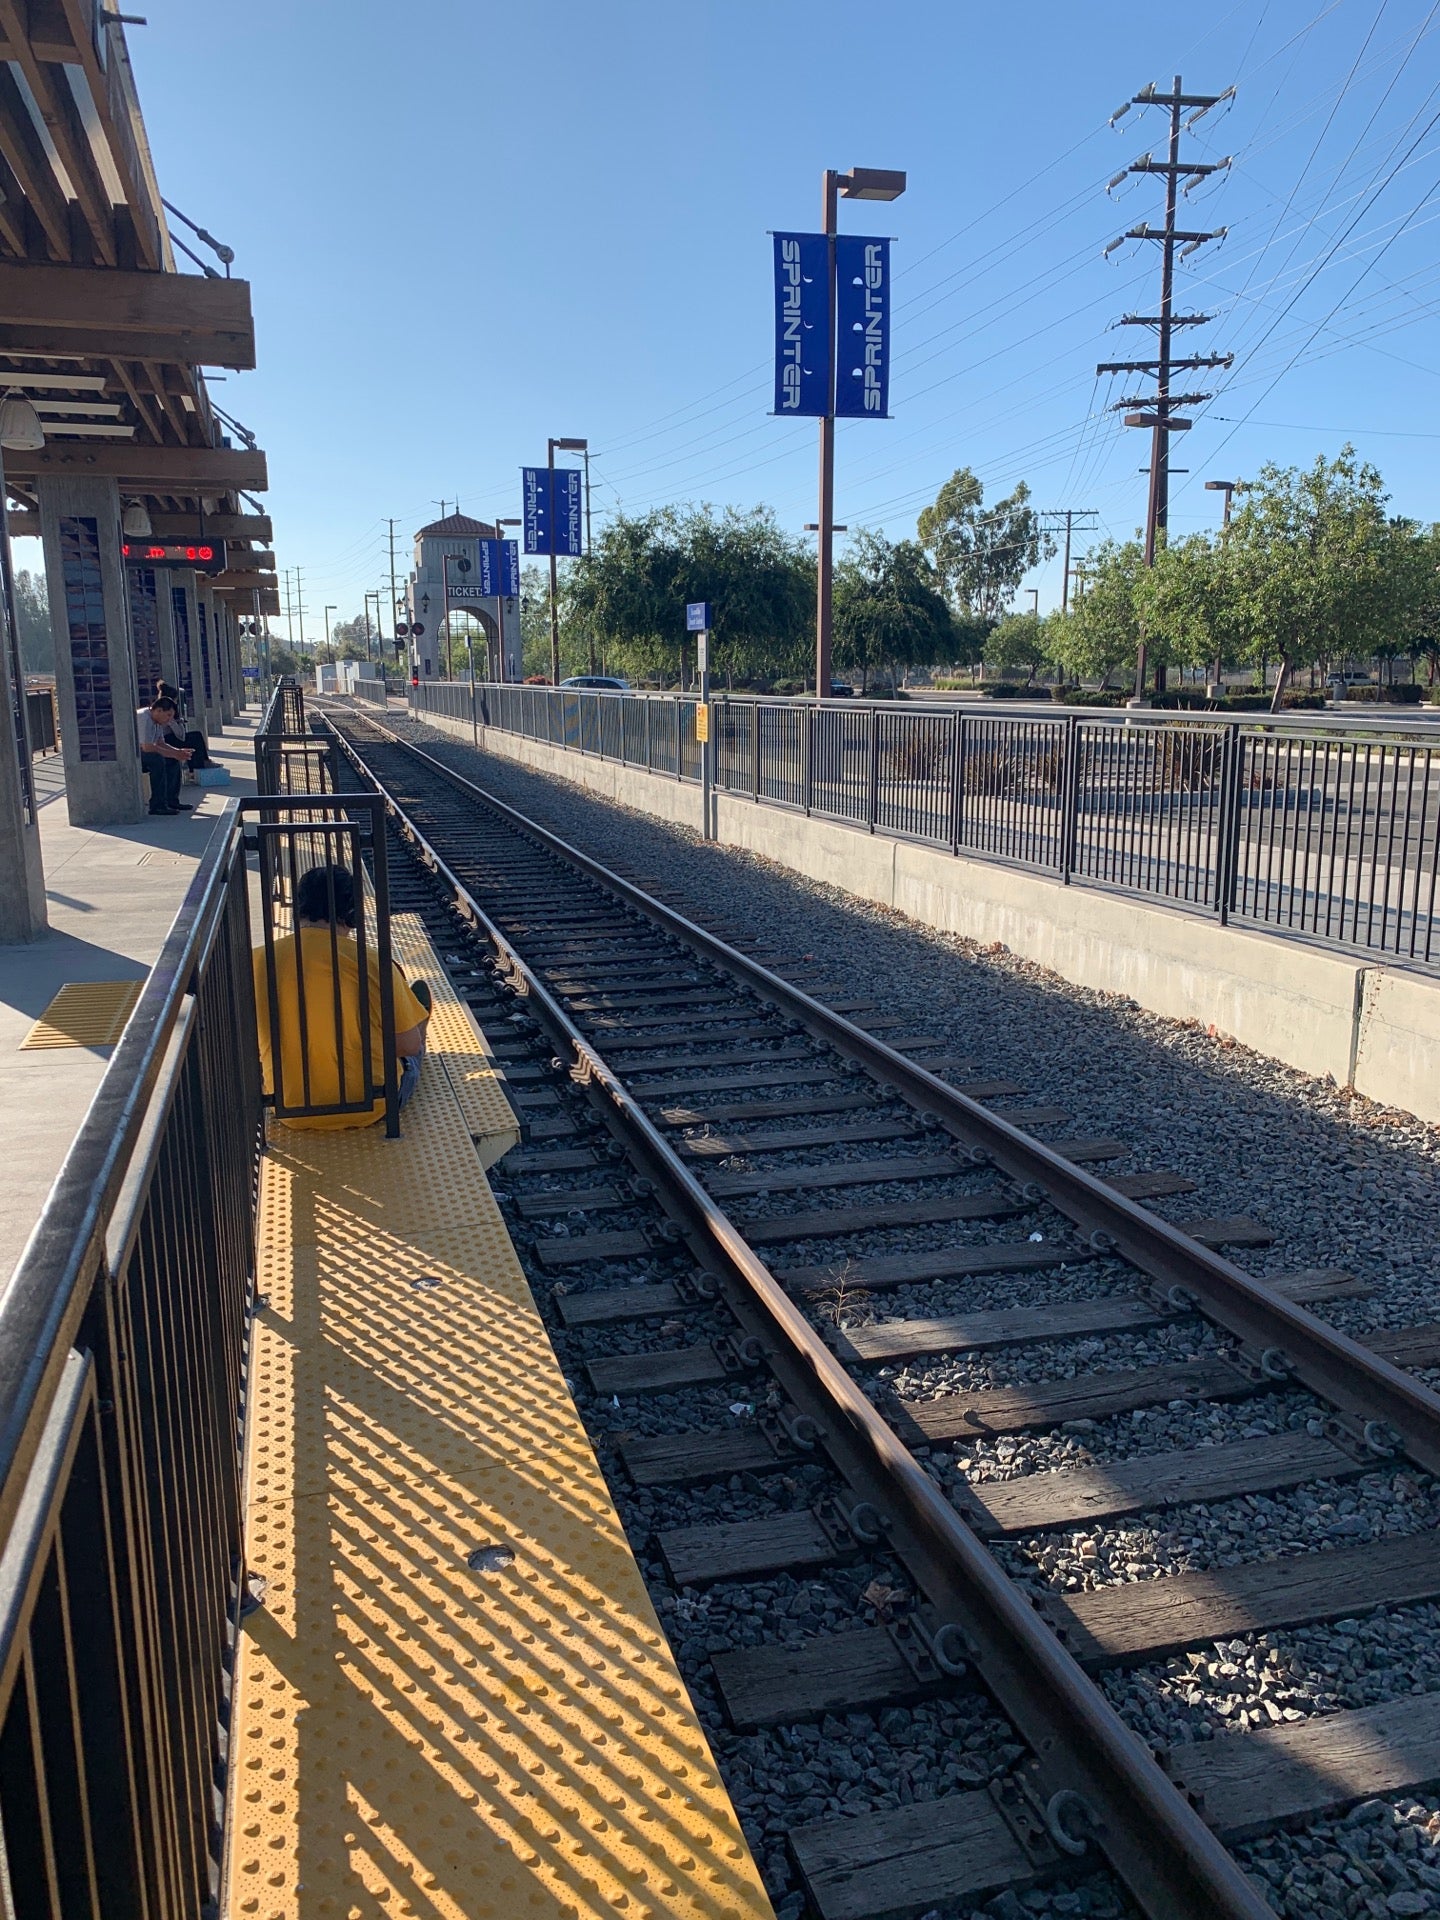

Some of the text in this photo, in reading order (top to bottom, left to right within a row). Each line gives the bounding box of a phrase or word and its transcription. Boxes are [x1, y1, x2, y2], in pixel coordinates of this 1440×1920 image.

[782, 239, 801, 409] SPRINTER
[864, 244, 882, 411] SPRINTER
[526, 470, 538, 552] SPRINTER
[568, 472, 579, 553] SPRINTER
[481, 541, 491, 594] SPRINTER
[509, 541, 518, 594] SPRINTER
